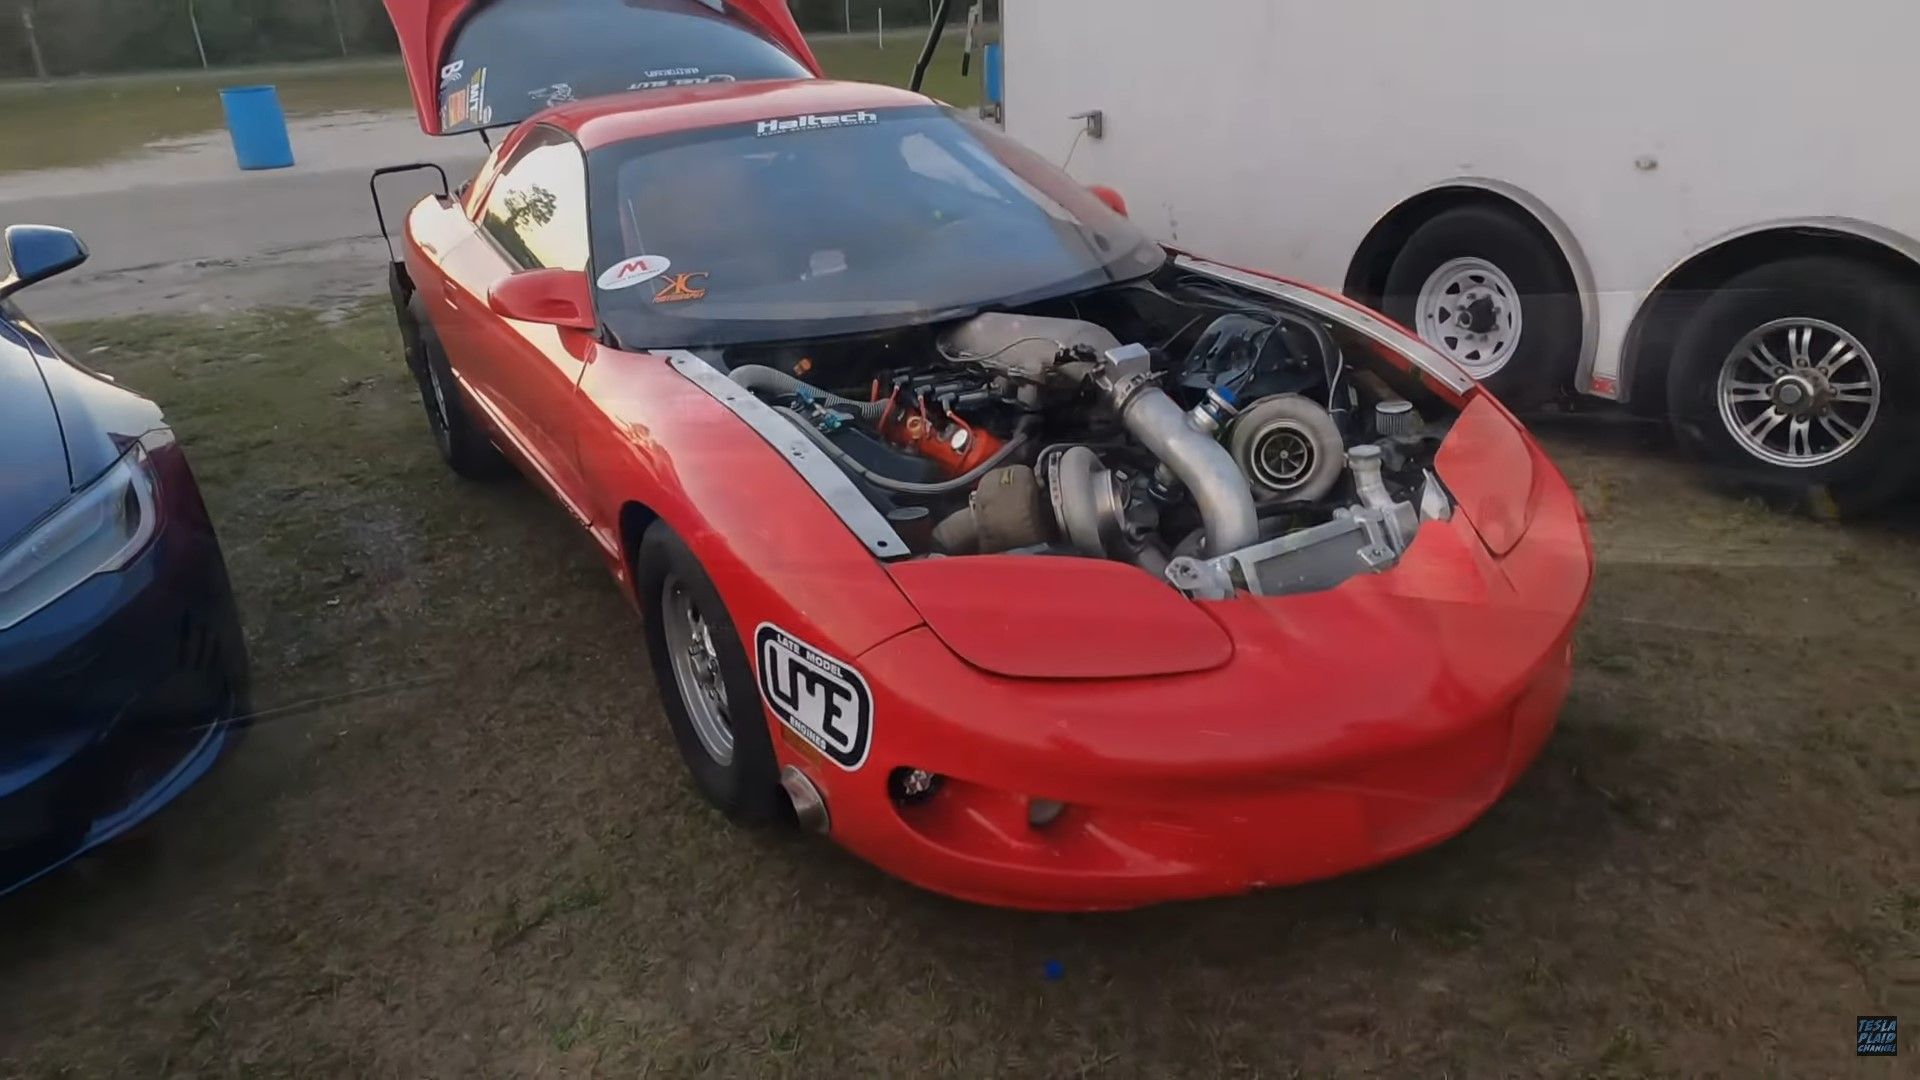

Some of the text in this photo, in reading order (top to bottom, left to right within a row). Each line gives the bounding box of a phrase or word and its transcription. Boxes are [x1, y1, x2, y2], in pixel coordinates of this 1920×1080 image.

[757, 111, 877, 134] Haltech
[777, 633, 844, 678] LATE MODEL
[789, 715, 827, 750] ENGINES
